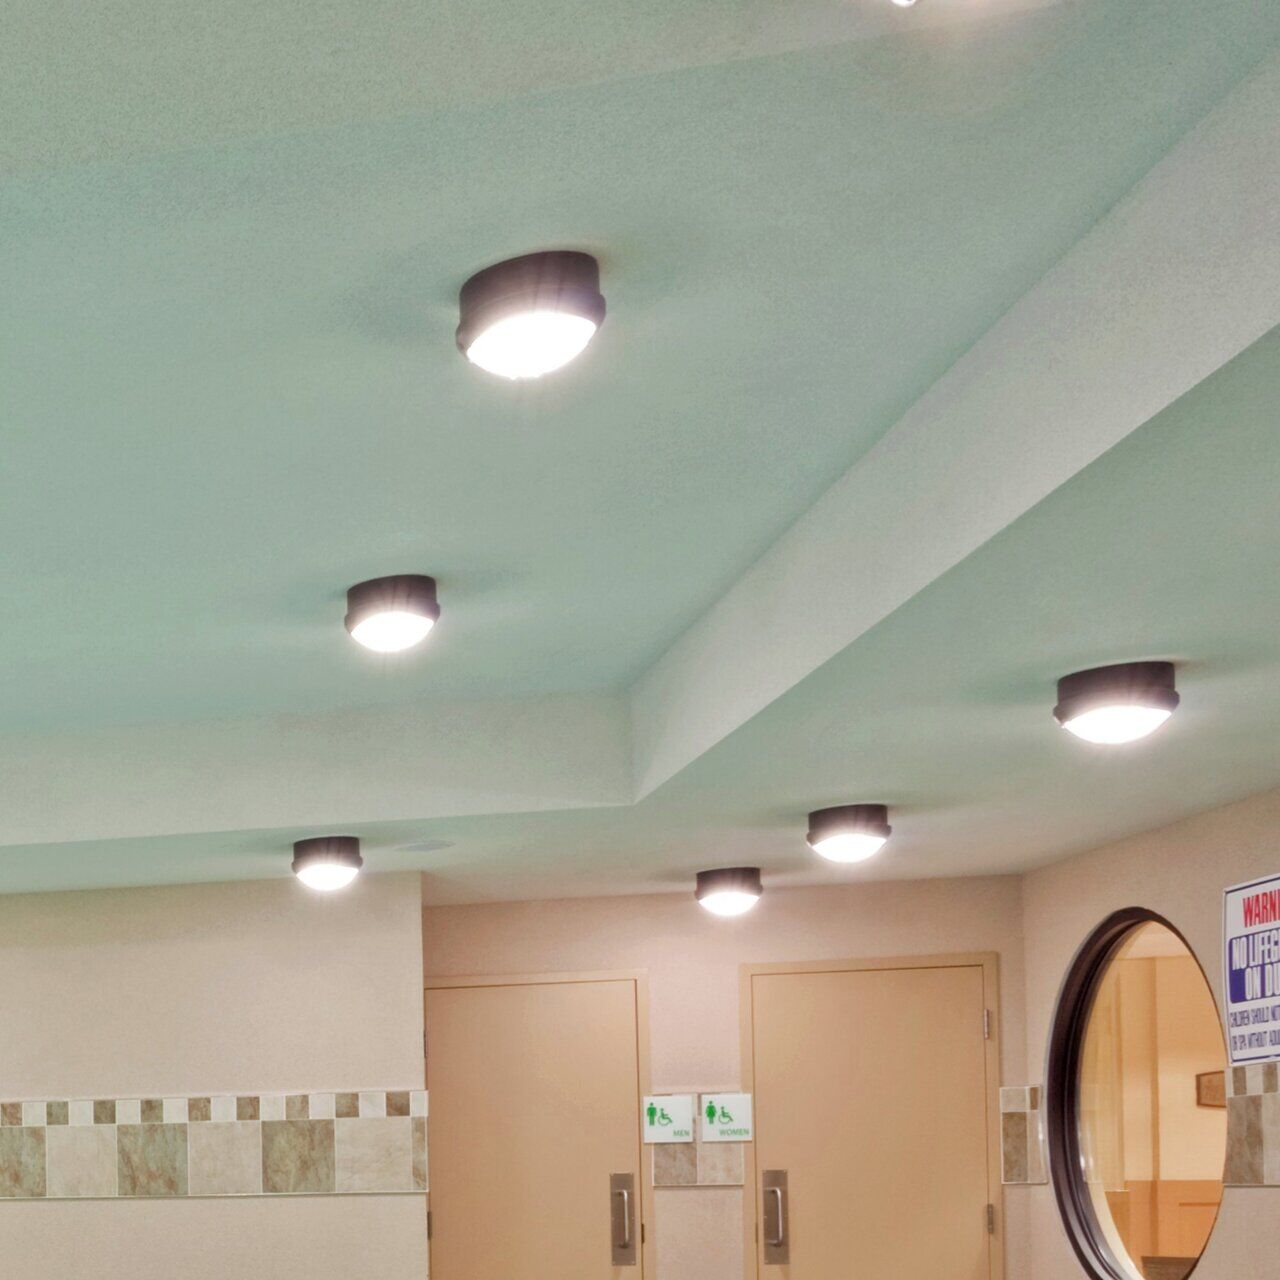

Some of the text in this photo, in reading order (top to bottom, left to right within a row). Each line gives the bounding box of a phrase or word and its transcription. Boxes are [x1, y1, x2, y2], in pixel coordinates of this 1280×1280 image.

[1243, 889, 1280, 928] WARNI
[1232, 929, 1280, 970] NO LIFEG
[1244, 962, 1280, 1000] ON DU
[719, 1128, 749, 1136] WOMEN
